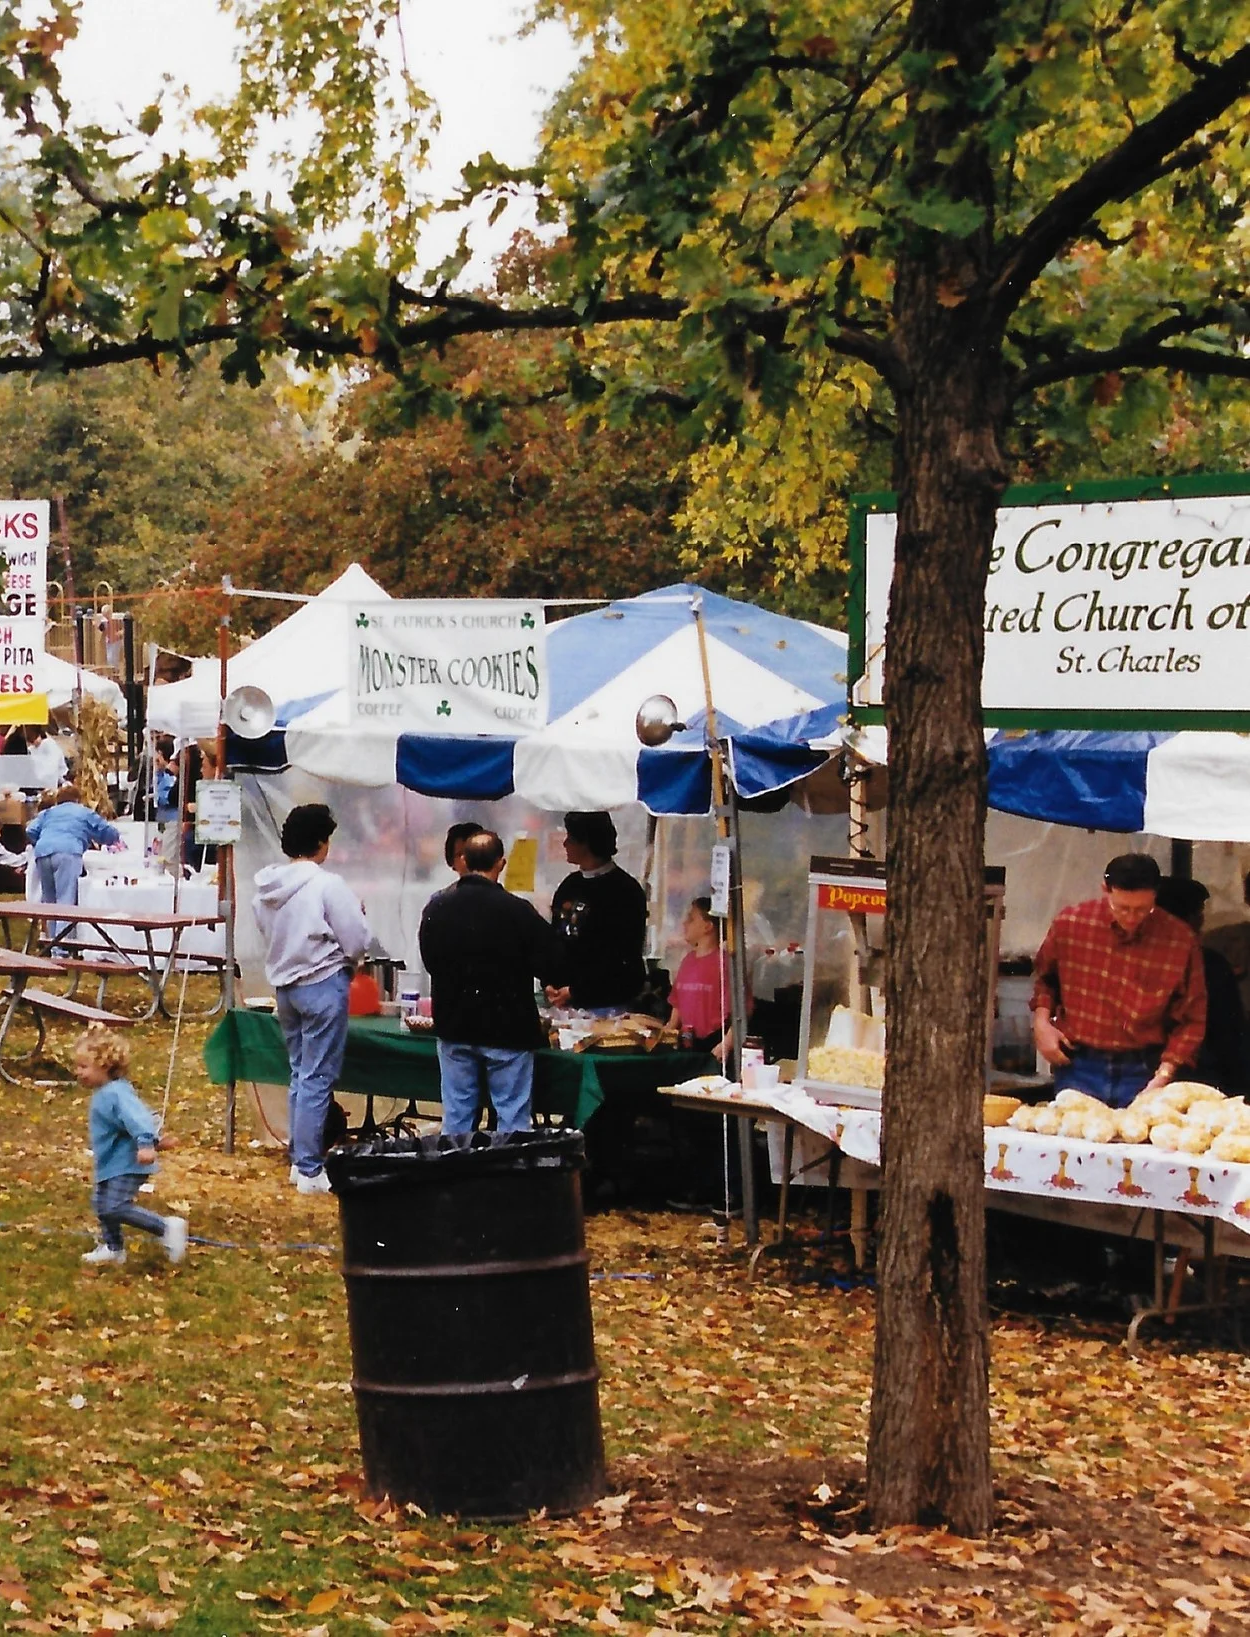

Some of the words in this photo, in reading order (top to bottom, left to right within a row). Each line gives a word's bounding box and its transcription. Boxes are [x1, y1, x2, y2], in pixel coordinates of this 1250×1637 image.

[461, 615, 517, 629] CHURCH
[984, 591, 1044, 633] ted
[1053, 587, 1194, 632] Church
[4, 647, 35, 667] PITA
[357, 644, 442, 696] MONSTER
[447, 645, 540, 701] COOKIES
[828, 885, 887, 910] Popcor
